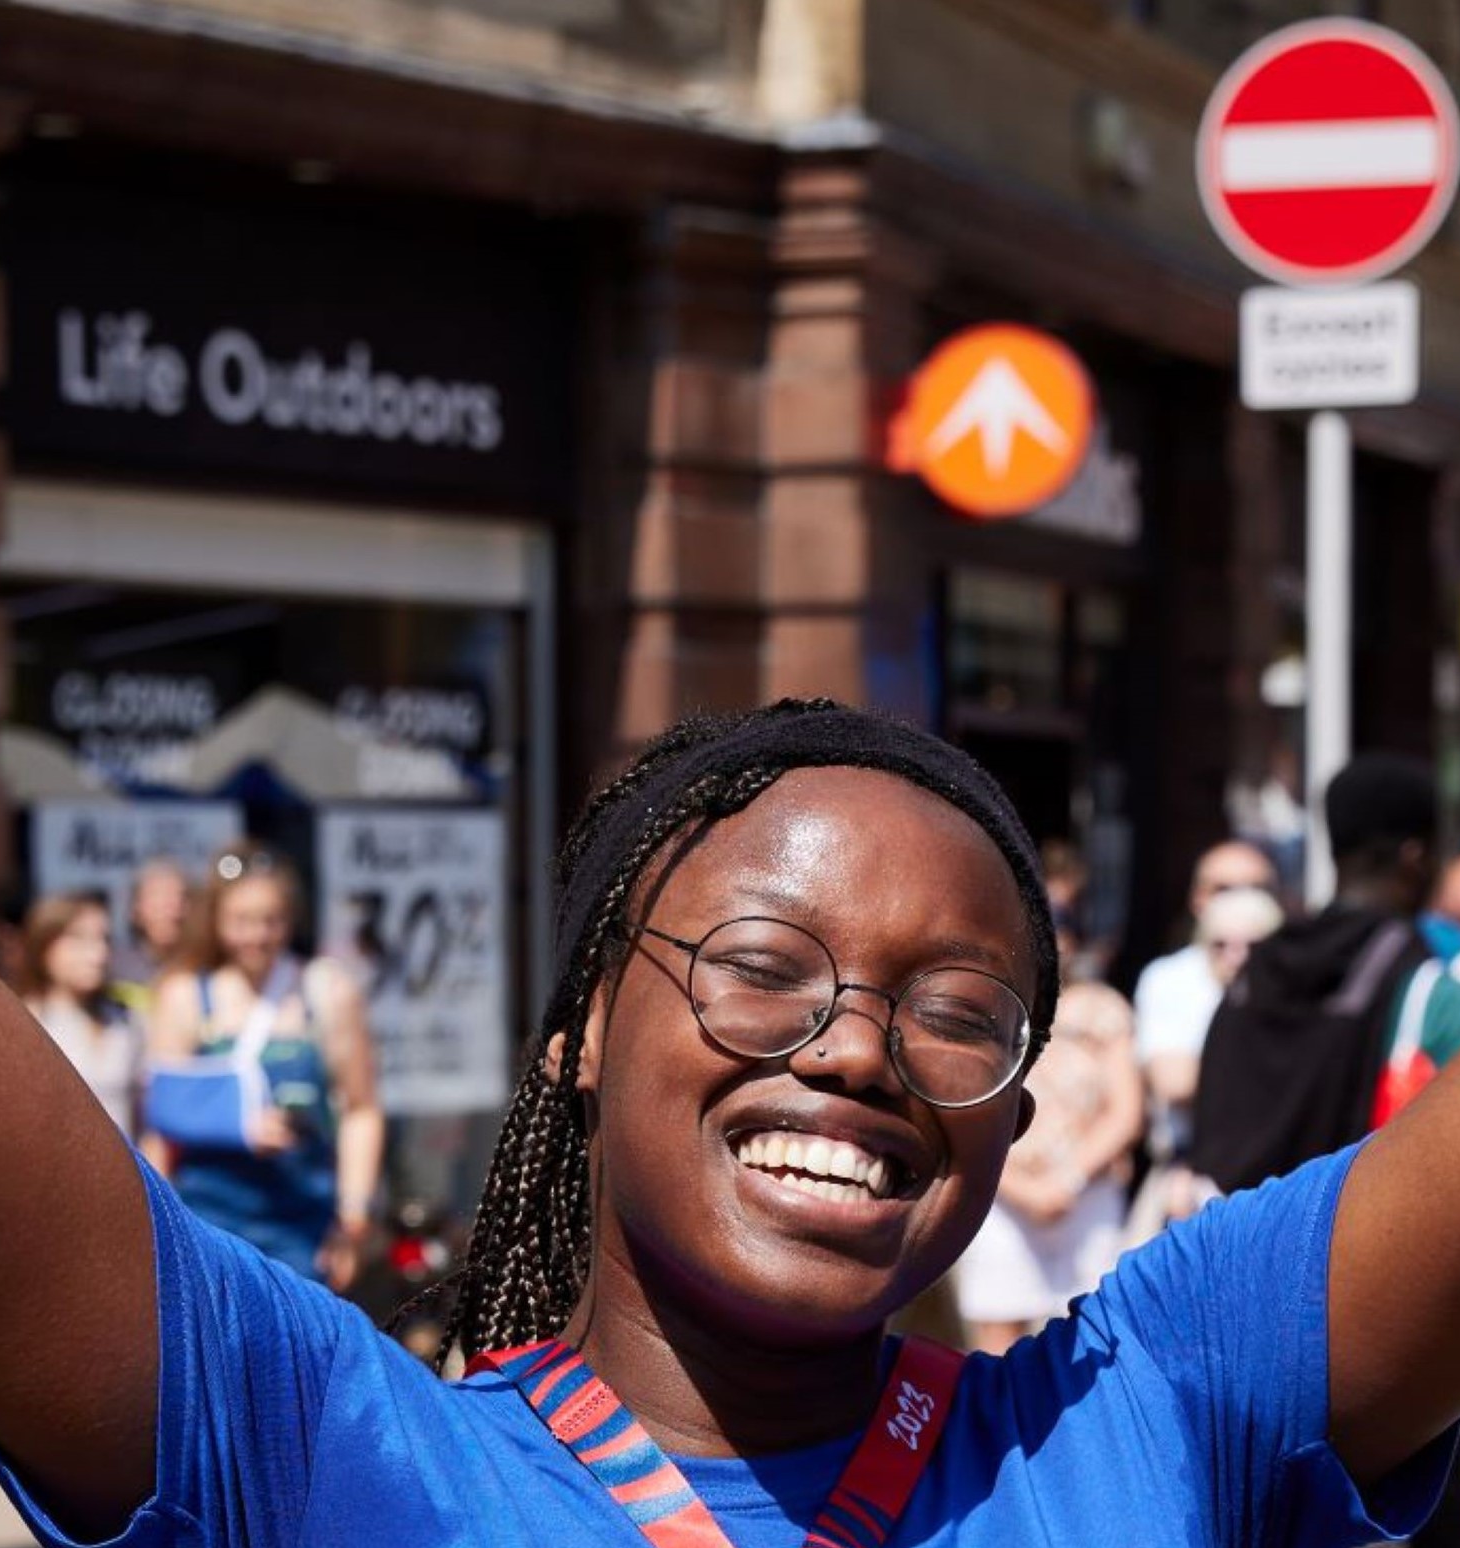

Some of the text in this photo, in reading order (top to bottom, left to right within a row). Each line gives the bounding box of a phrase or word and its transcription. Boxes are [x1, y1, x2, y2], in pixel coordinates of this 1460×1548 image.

[58, 307, 503, 452] Life Outdoors
[886, 1380, 935, 1451] 2023
